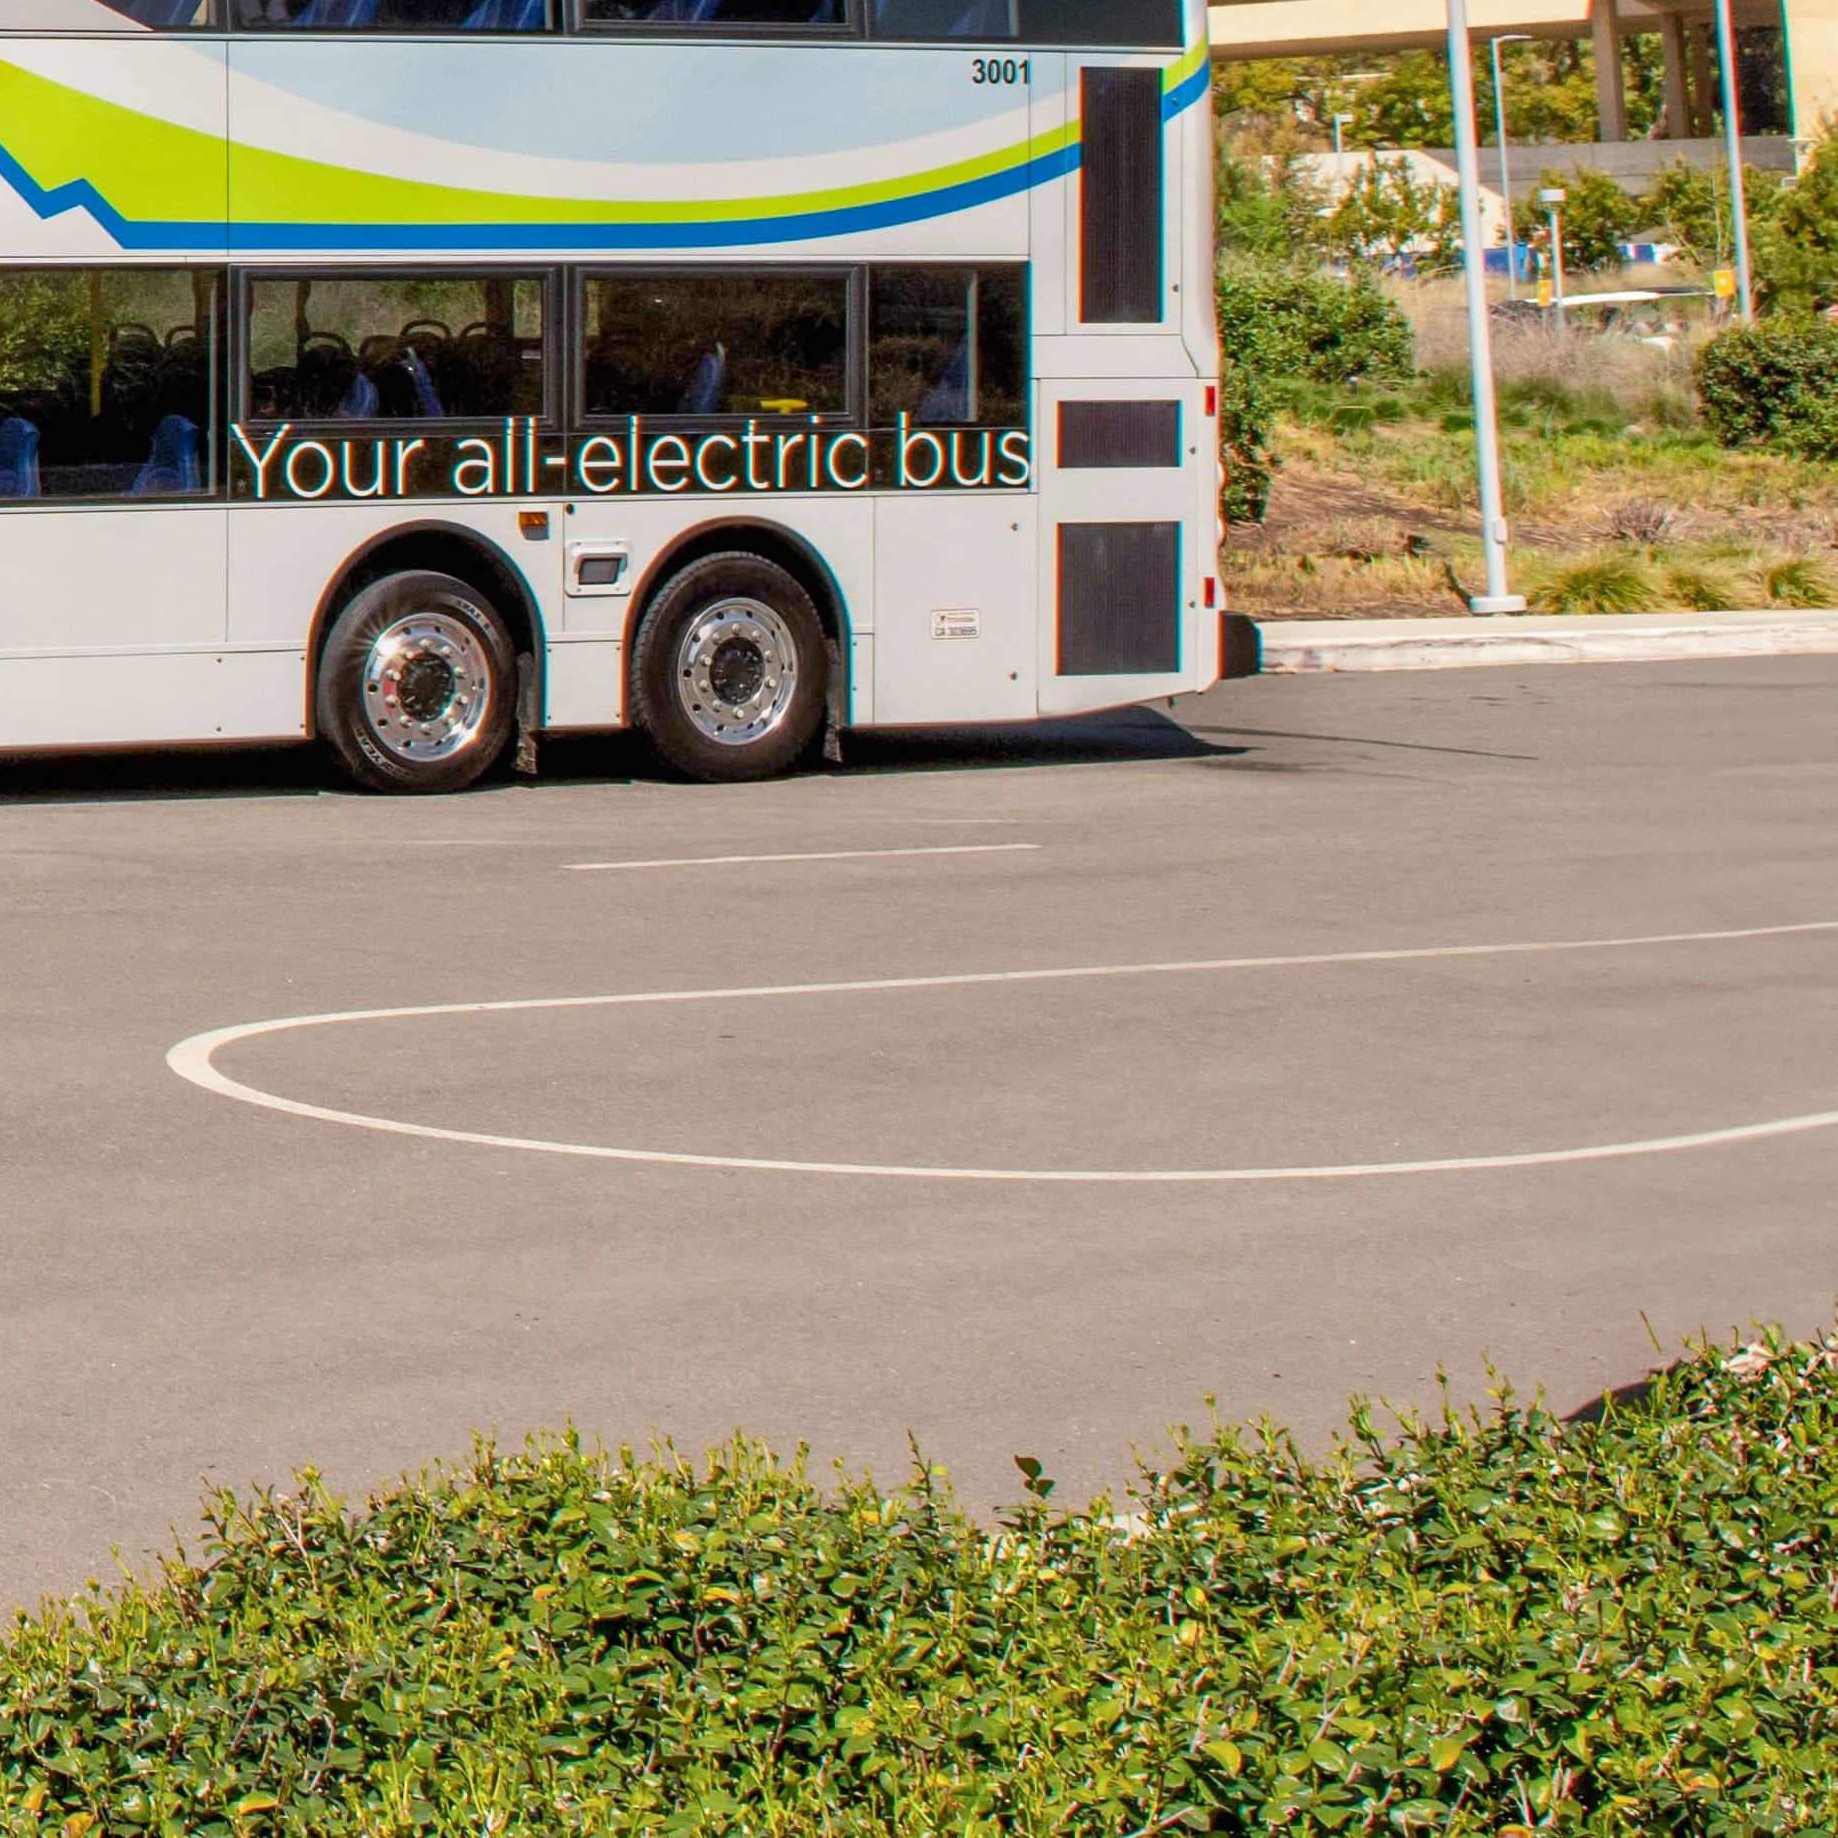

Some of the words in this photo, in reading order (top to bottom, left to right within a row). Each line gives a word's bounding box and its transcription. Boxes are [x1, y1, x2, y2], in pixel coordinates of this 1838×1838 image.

[972, 59, 1029, 85] 3001
[230, 422, 425, 498] Your
[452, 414, 870, 495] all-electric
[897, 410, 1030, 487] bus
